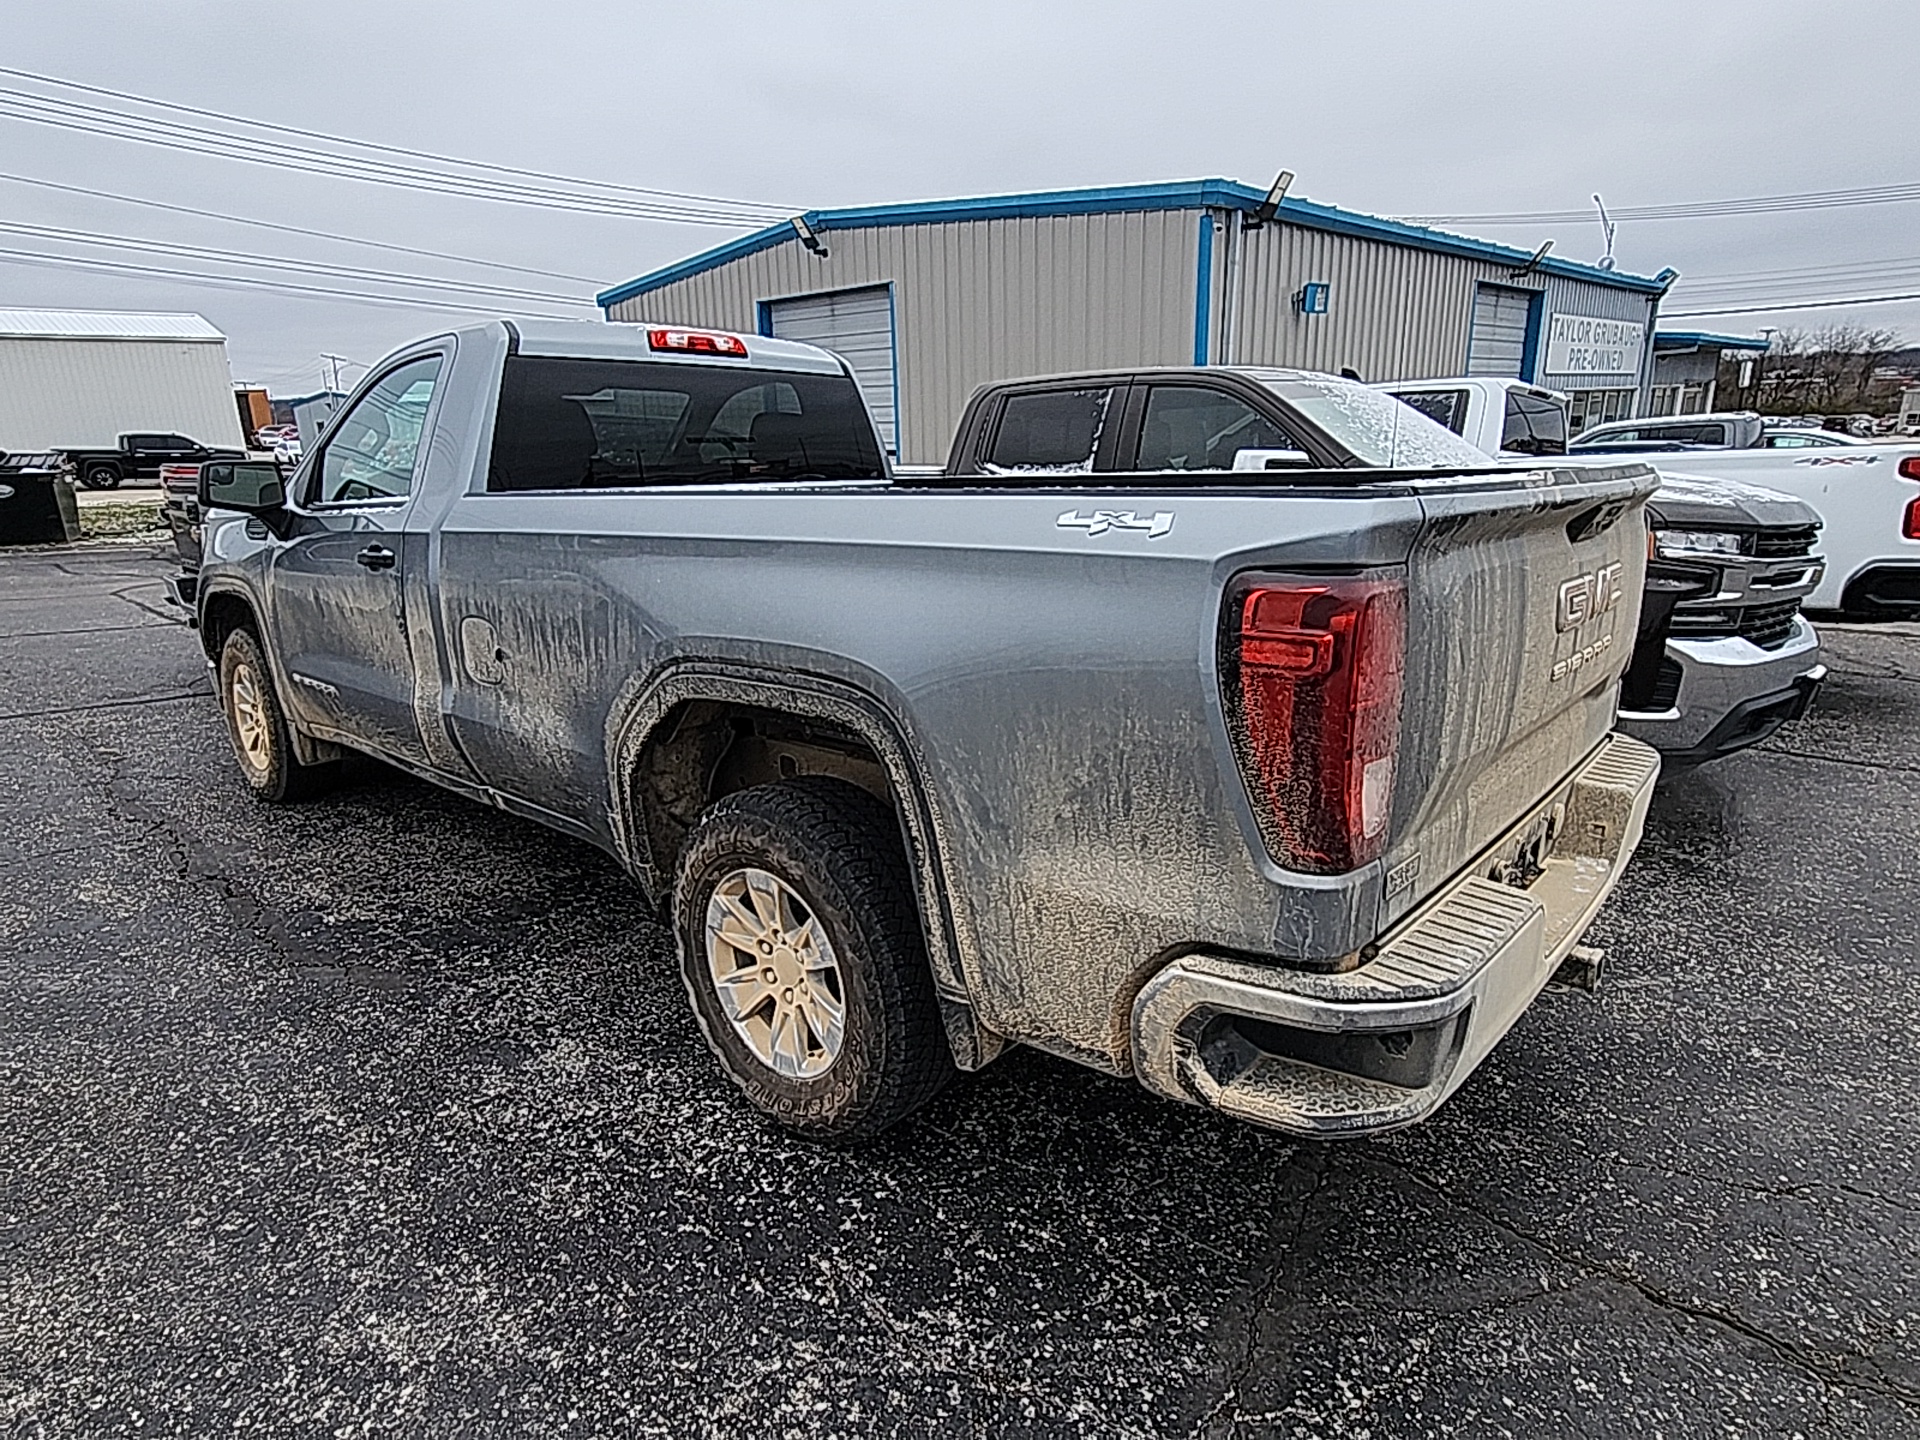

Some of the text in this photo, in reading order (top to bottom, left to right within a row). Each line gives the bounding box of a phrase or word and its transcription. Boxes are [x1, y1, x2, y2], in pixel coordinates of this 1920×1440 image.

[1553, 317, 1592, 344] TAYLOR
[1567, 347, 1624, 371] PRE-OWNED
[1555, 559, 1622, 634] GMC
[1549, 634, 1612, 683] SIERRA
